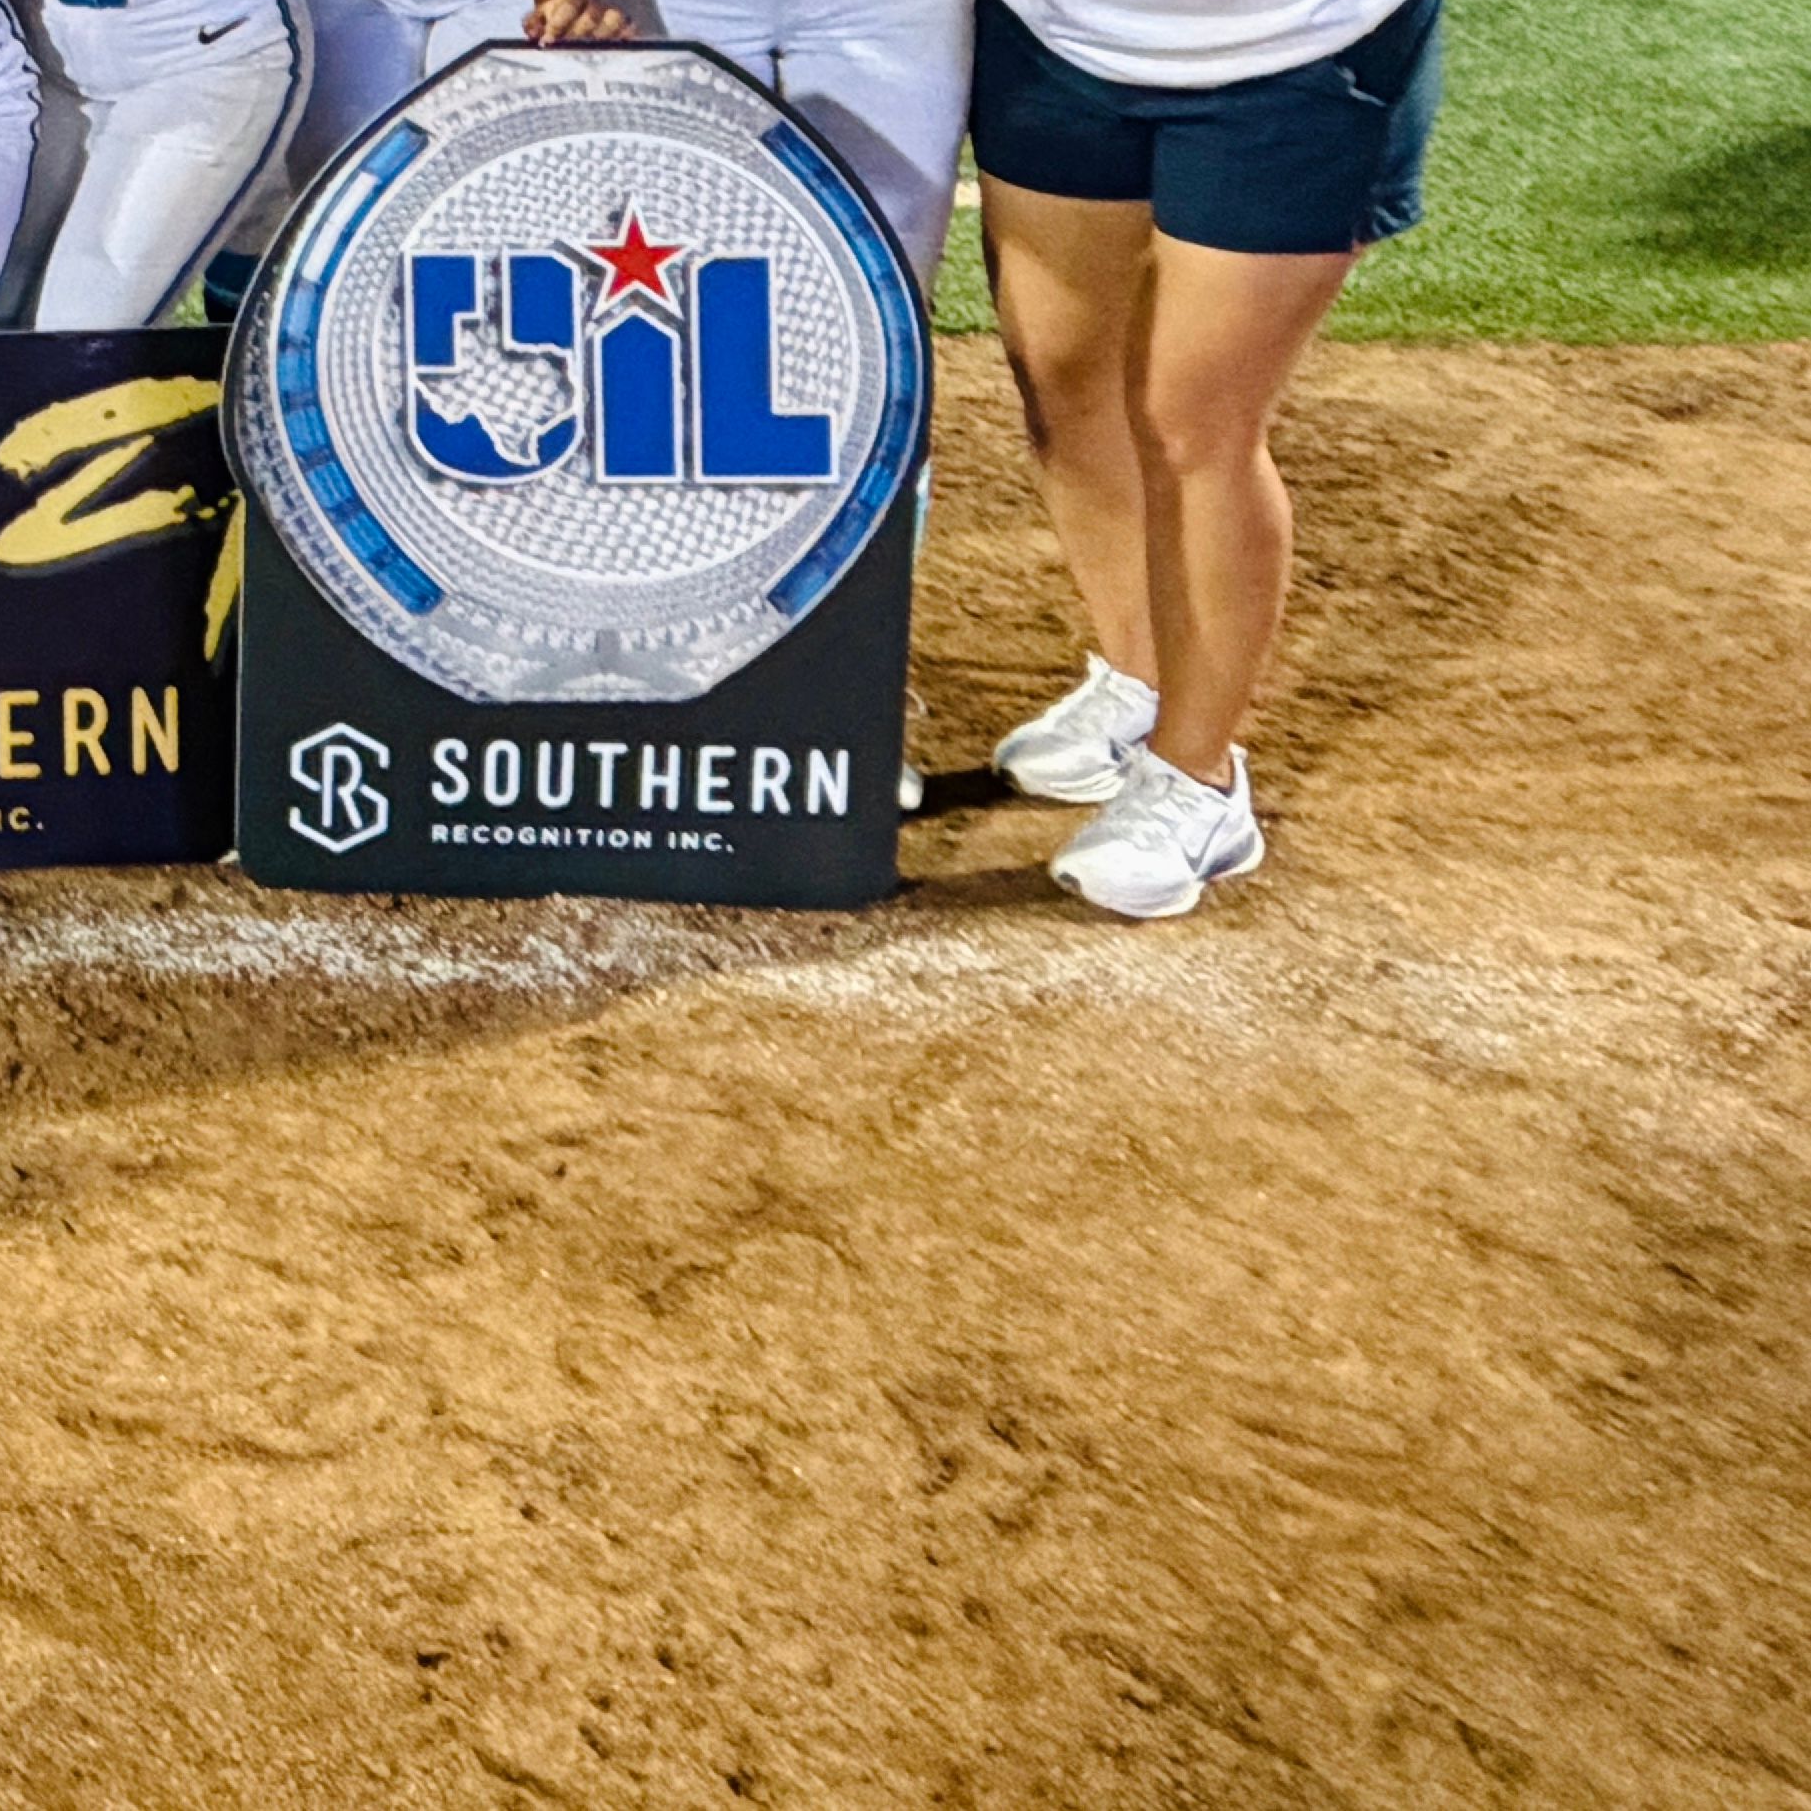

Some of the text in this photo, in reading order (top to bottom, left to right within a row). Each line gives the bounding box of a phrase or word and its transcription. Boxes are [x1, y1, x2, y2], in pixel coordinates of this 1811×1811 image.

[429, 736, 852, 818] SOUTHERN
[431, 823, 736, 855] RECOGNITION INC.
